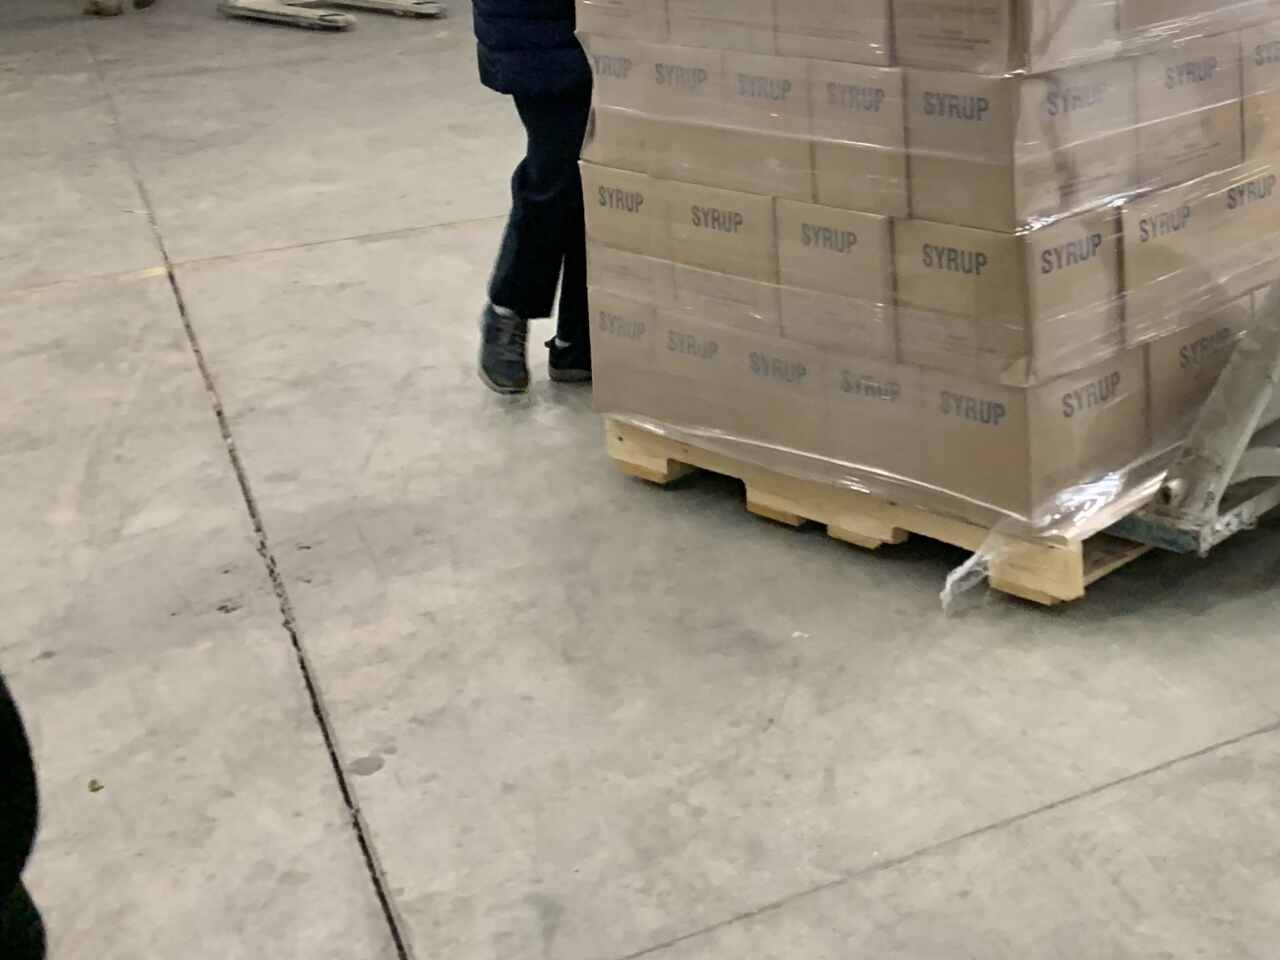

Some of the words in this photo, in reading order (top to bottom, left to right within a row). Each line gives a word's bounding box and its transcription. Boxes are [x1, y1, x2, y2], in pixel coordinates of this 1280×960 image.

[655, 63, 708, 88] SYRUP
[736, 73, 791, 101] SYRUP
[1165, 56, 1218, 89] SYRUP
[826, 82, 886, 112] SYRUP
[923, 91, 989, 121] SYRUP
[598, 186, 644, 214] SYRUP
[1227, 174, 1278, 210] SYRUP
[692, 205, 743, 233] SYRUP
[1139, 205, 1192, 242] SYRUP
[801, 223, 857, 254] SYRUP
[1041, 233, 1103, 275] SYRUP
[923, 243, 988, 276] SYRUP
[599, 311, 646, 342] SYRUP
[667, 330, 720, 360] SYRUP
[748, 351, 807, 384] SYRUP
[938, 390, 1007, 427] SYRUP
[1062, 371, 1121, 418] SYRUP
